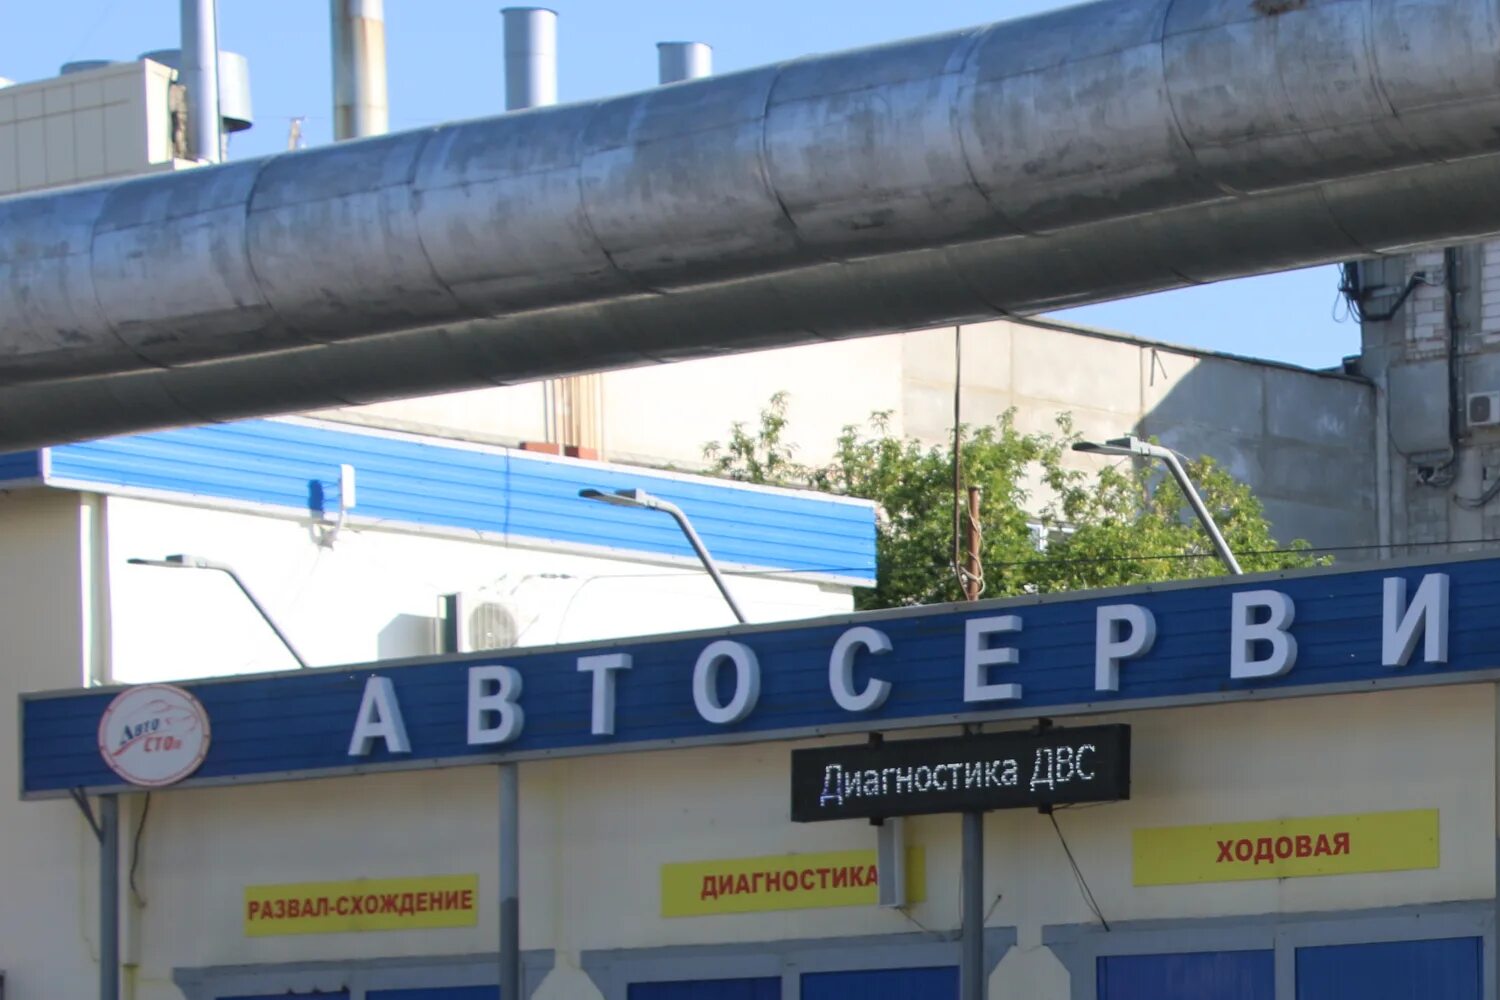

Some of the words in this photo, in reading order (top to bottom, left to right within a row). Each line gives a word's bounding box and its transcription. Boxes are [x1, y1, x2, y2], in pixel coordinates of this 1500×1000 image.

[820, 758, 1018, 807] Диагностика
[1030, 743, 1096, 792] ДВС
[1215, 831, 1350, 865] ХОДОВАЯ
[701, 864, 879, 901] ДИАГНОСТИКА
[247, 889, 473, 921] РАЗВАЛ-СХОЖДЕНИЕ
